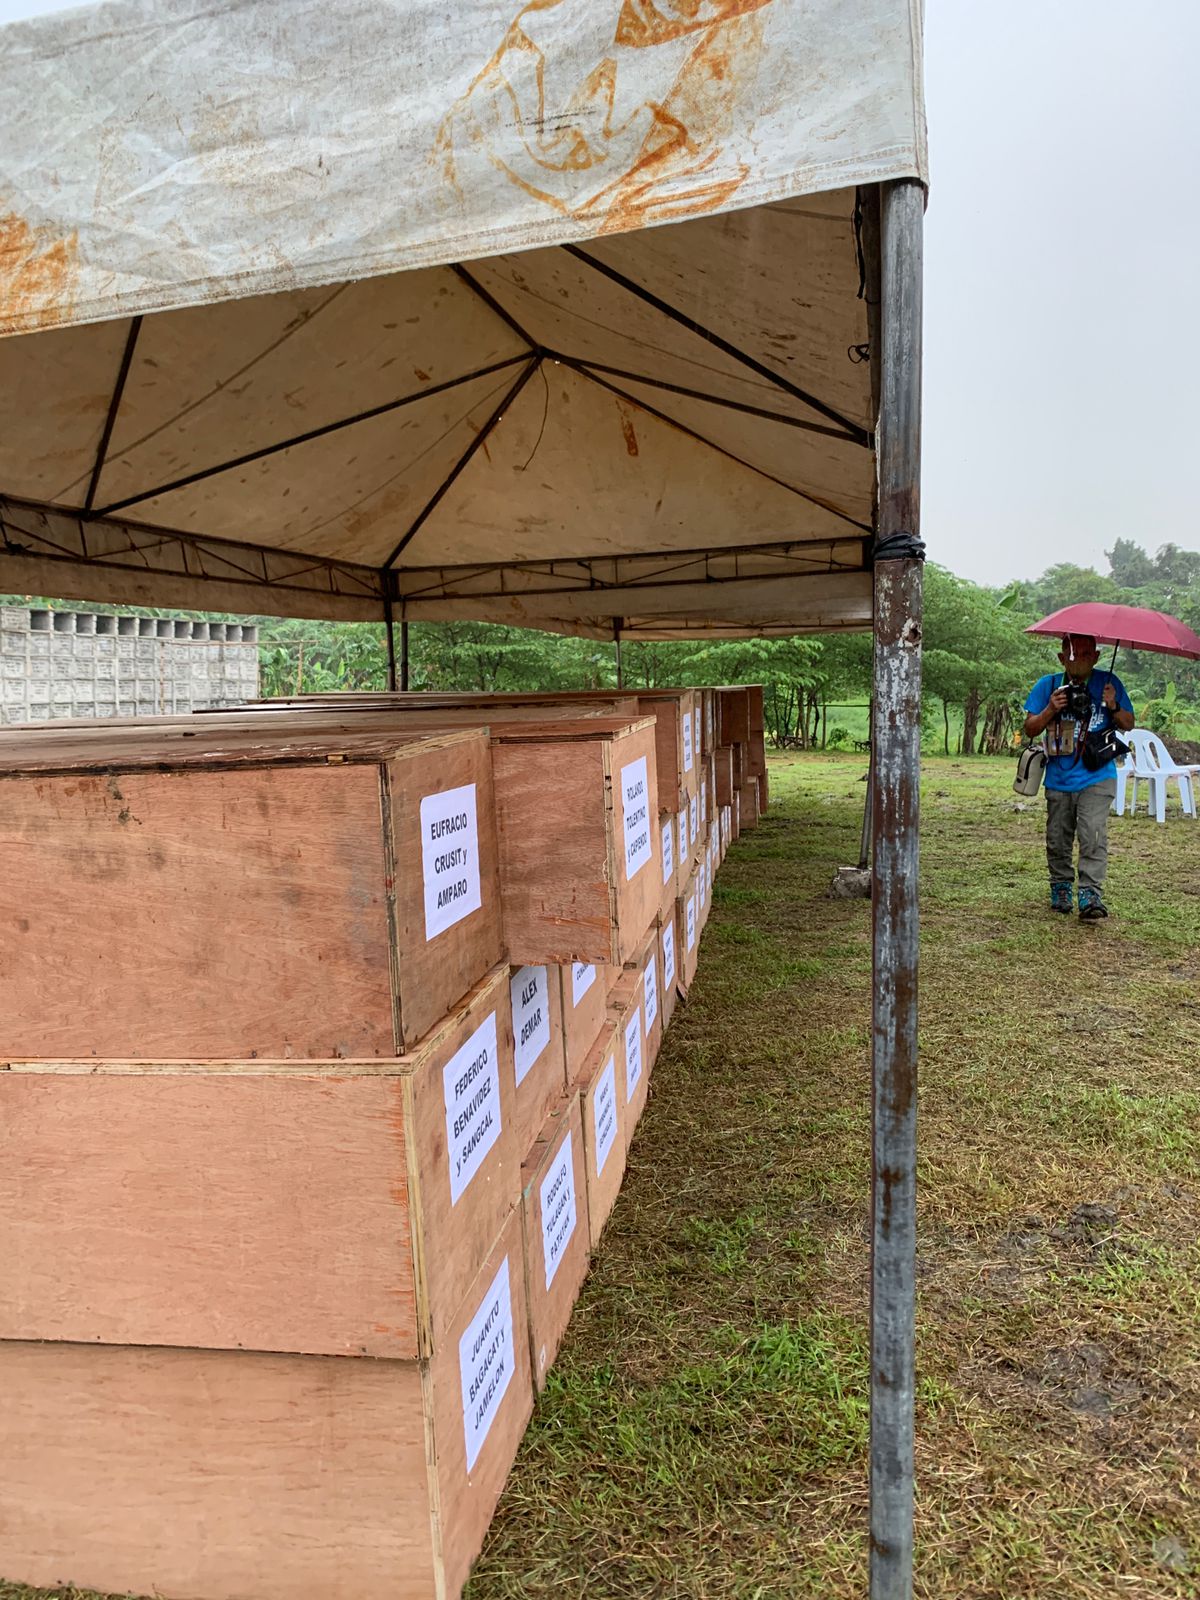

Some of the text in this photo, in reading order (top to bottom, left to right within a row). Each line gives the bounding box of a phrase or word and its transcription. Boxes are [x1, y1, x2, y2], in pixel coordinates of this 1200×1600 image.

[626, 780, 644, 802] ROLANDO
[430, 812, 468, 840] EUFRACIO
[626, 805, 646, 831] TOLENTINO
[434, 848, 468, 874] CRUSIT y
[437, 878, 468, 909] AMPARO
[521, 976, 538, 1008] ALEX
[520, 1007, 542, 1047] DEMAR
[454, 1048, 488, 1101] FEDERICO
[453, 1076, 492, 1140] BENAVIDEZ
[456, 1110, 494, 1178] y SANGCAL
[546, 1163, 567, 1209] RODOLFO
[546, 1190, 568, 1237] TULAGAN
[471, 1299, 500, 1363] JUANITO
[469, 1331, 501, 1405] BAGACAY
[474, 1359, 505, 1431] JAMELON
